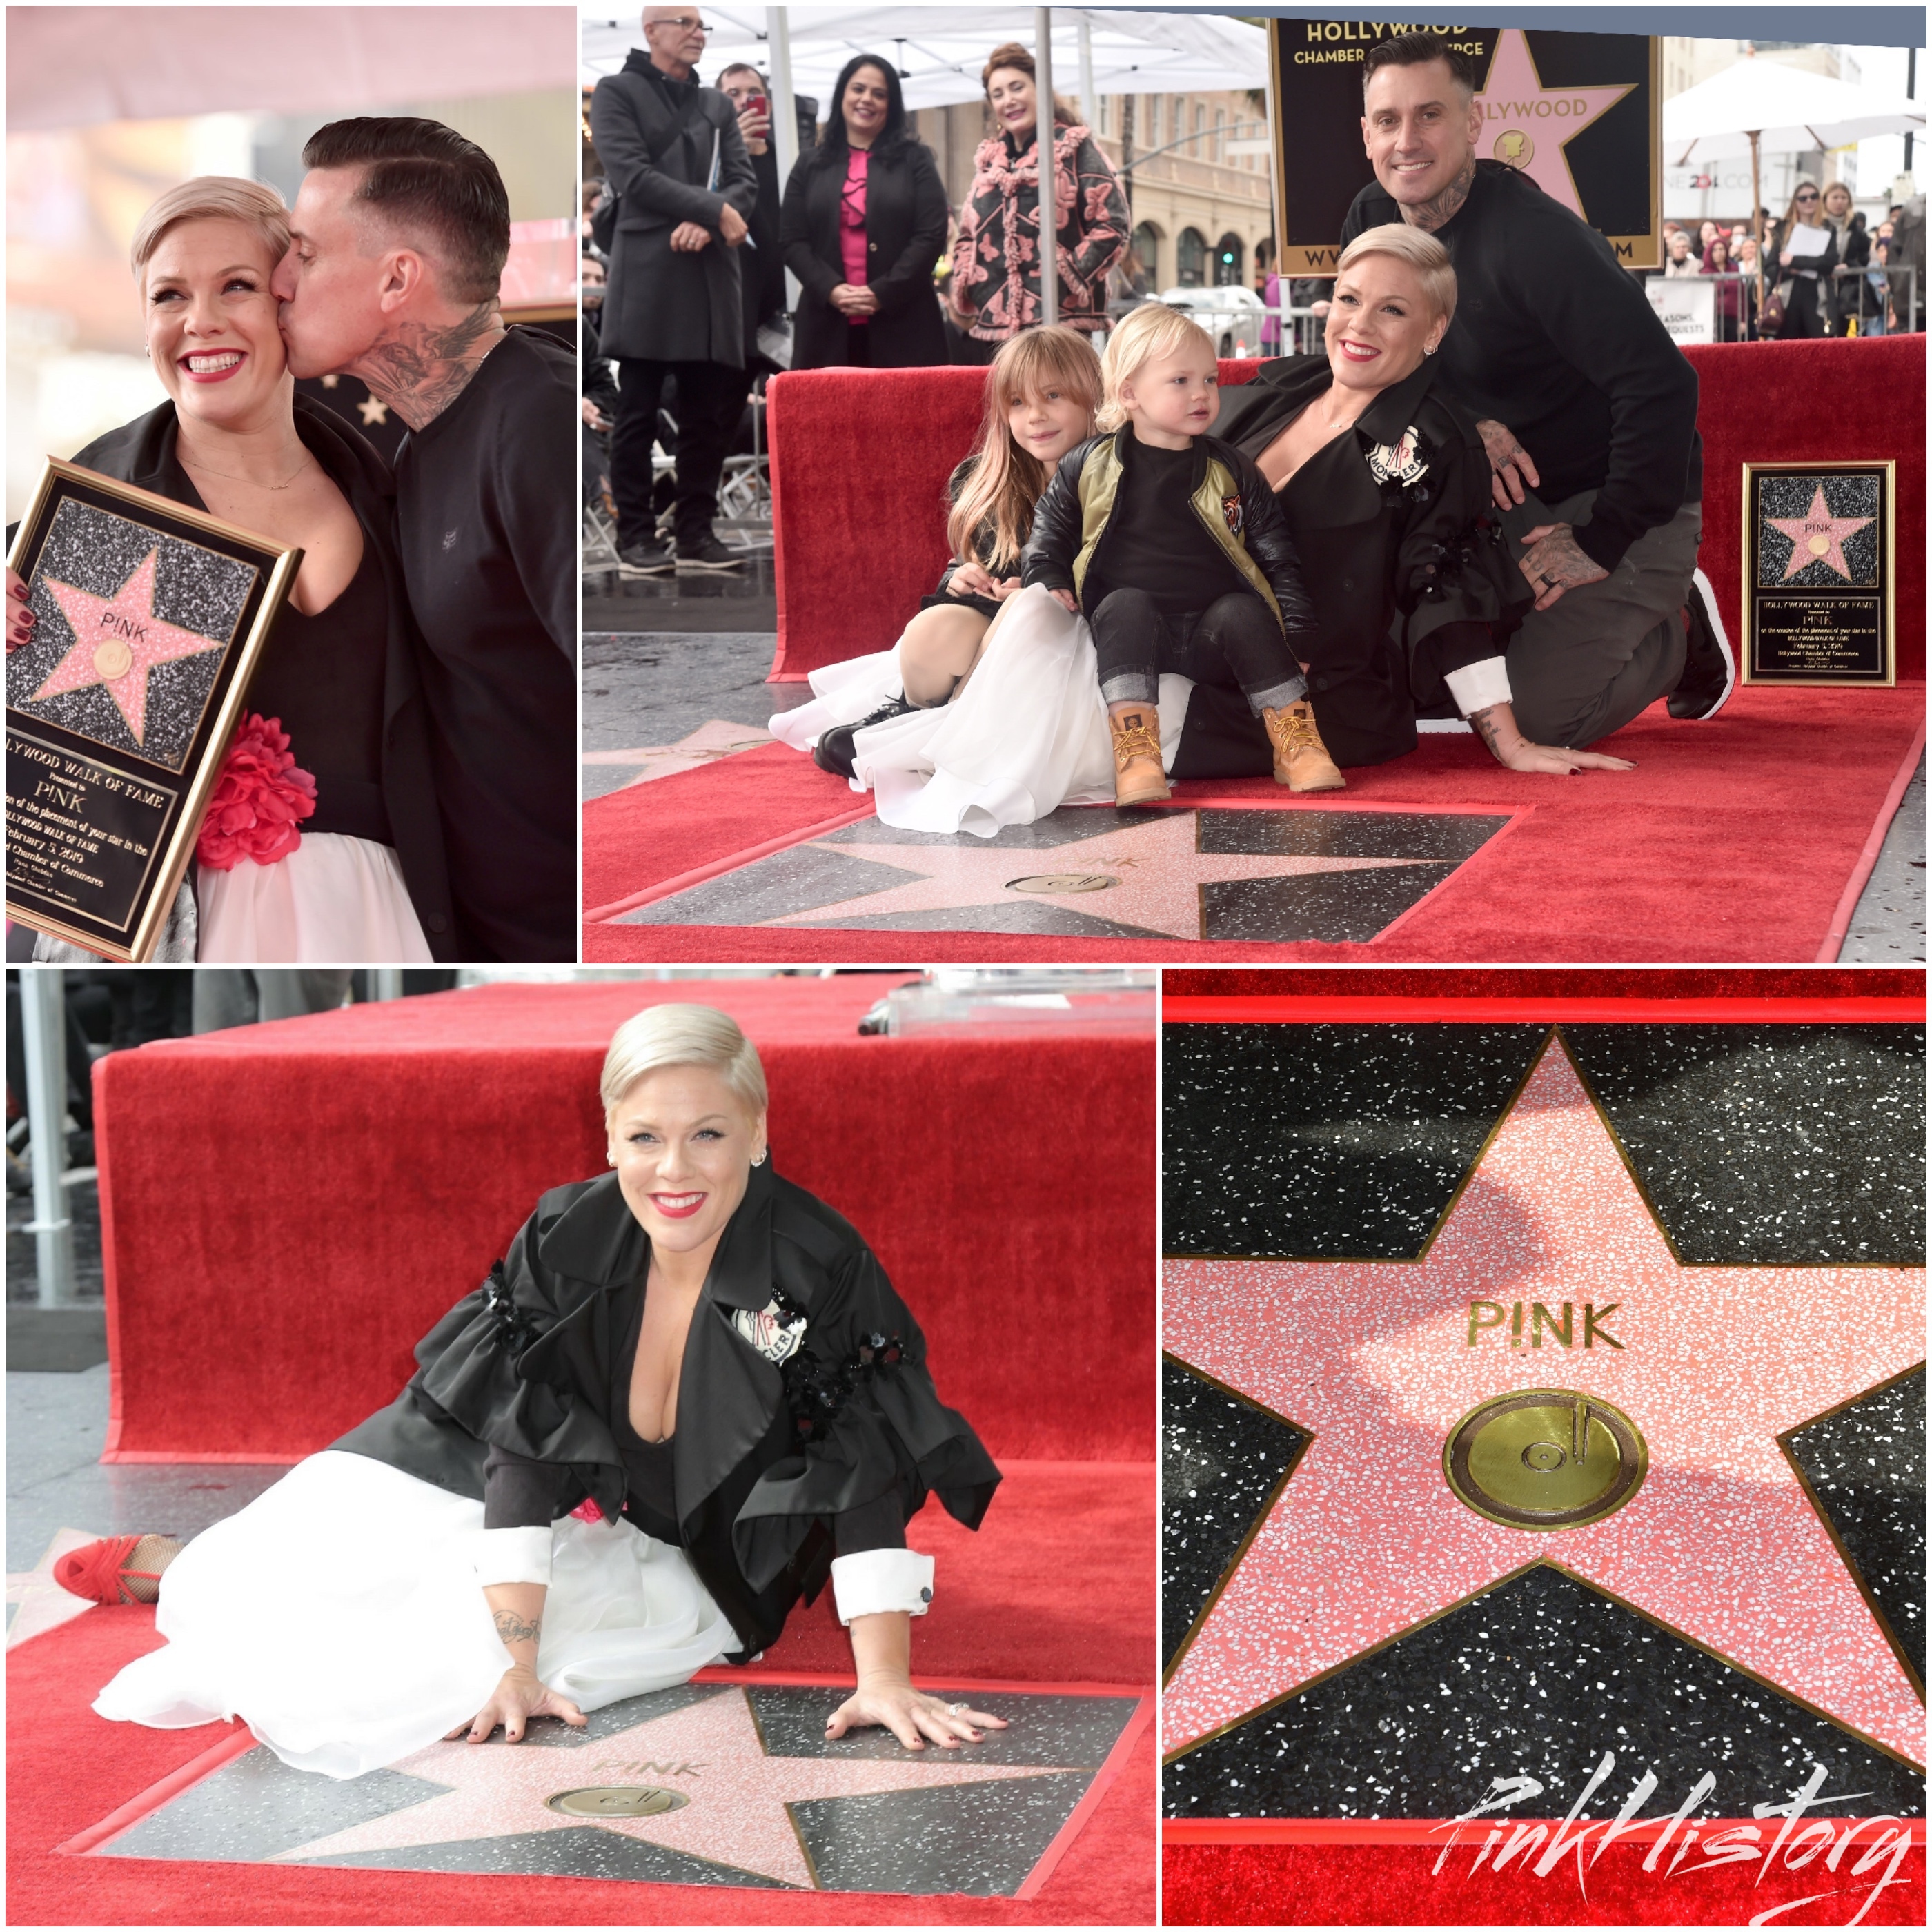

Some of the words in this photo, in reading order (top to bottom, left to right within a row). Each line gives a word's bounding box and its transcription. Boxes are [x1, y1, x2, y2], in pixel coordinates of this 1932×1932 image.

[1294, 48, 1365, 63] CHAMBER
[1483, 99, 1587, 120] LYWOOD
[49, 772, 79, 789] Presented
[78, 782, 86, 792] to
[65, 760, 103, 785] WALK
[106, 777, 124, 793] OF
[125, 784, 165, 809] FAME
[6, 824, 46, 850] February
[59, 847, 84, 864] 2019
[16, 798, 26, 809] of
[26, 802, 39, 814] the
[39, 807, 78, 829] placement
[79, 822, 89, 833] of
[87, 827, 108, 840] your
[107, 834, 124, 847] star
[124, 839, 132, 850] in
[134, 843, 148, 856] the
[43, 825, 66, 841] WALK
[66, 834, 77, 845] OF
[77, 838, 100, 854] FAME
[12, 845, 48, 865] Chamber
[50, 860, 60, 869] of
[61, 863, 104, 887] Commerce
[1467, 1301, 1627, 1349] P!NK
[762, 1334, 790, 1360] CLER
